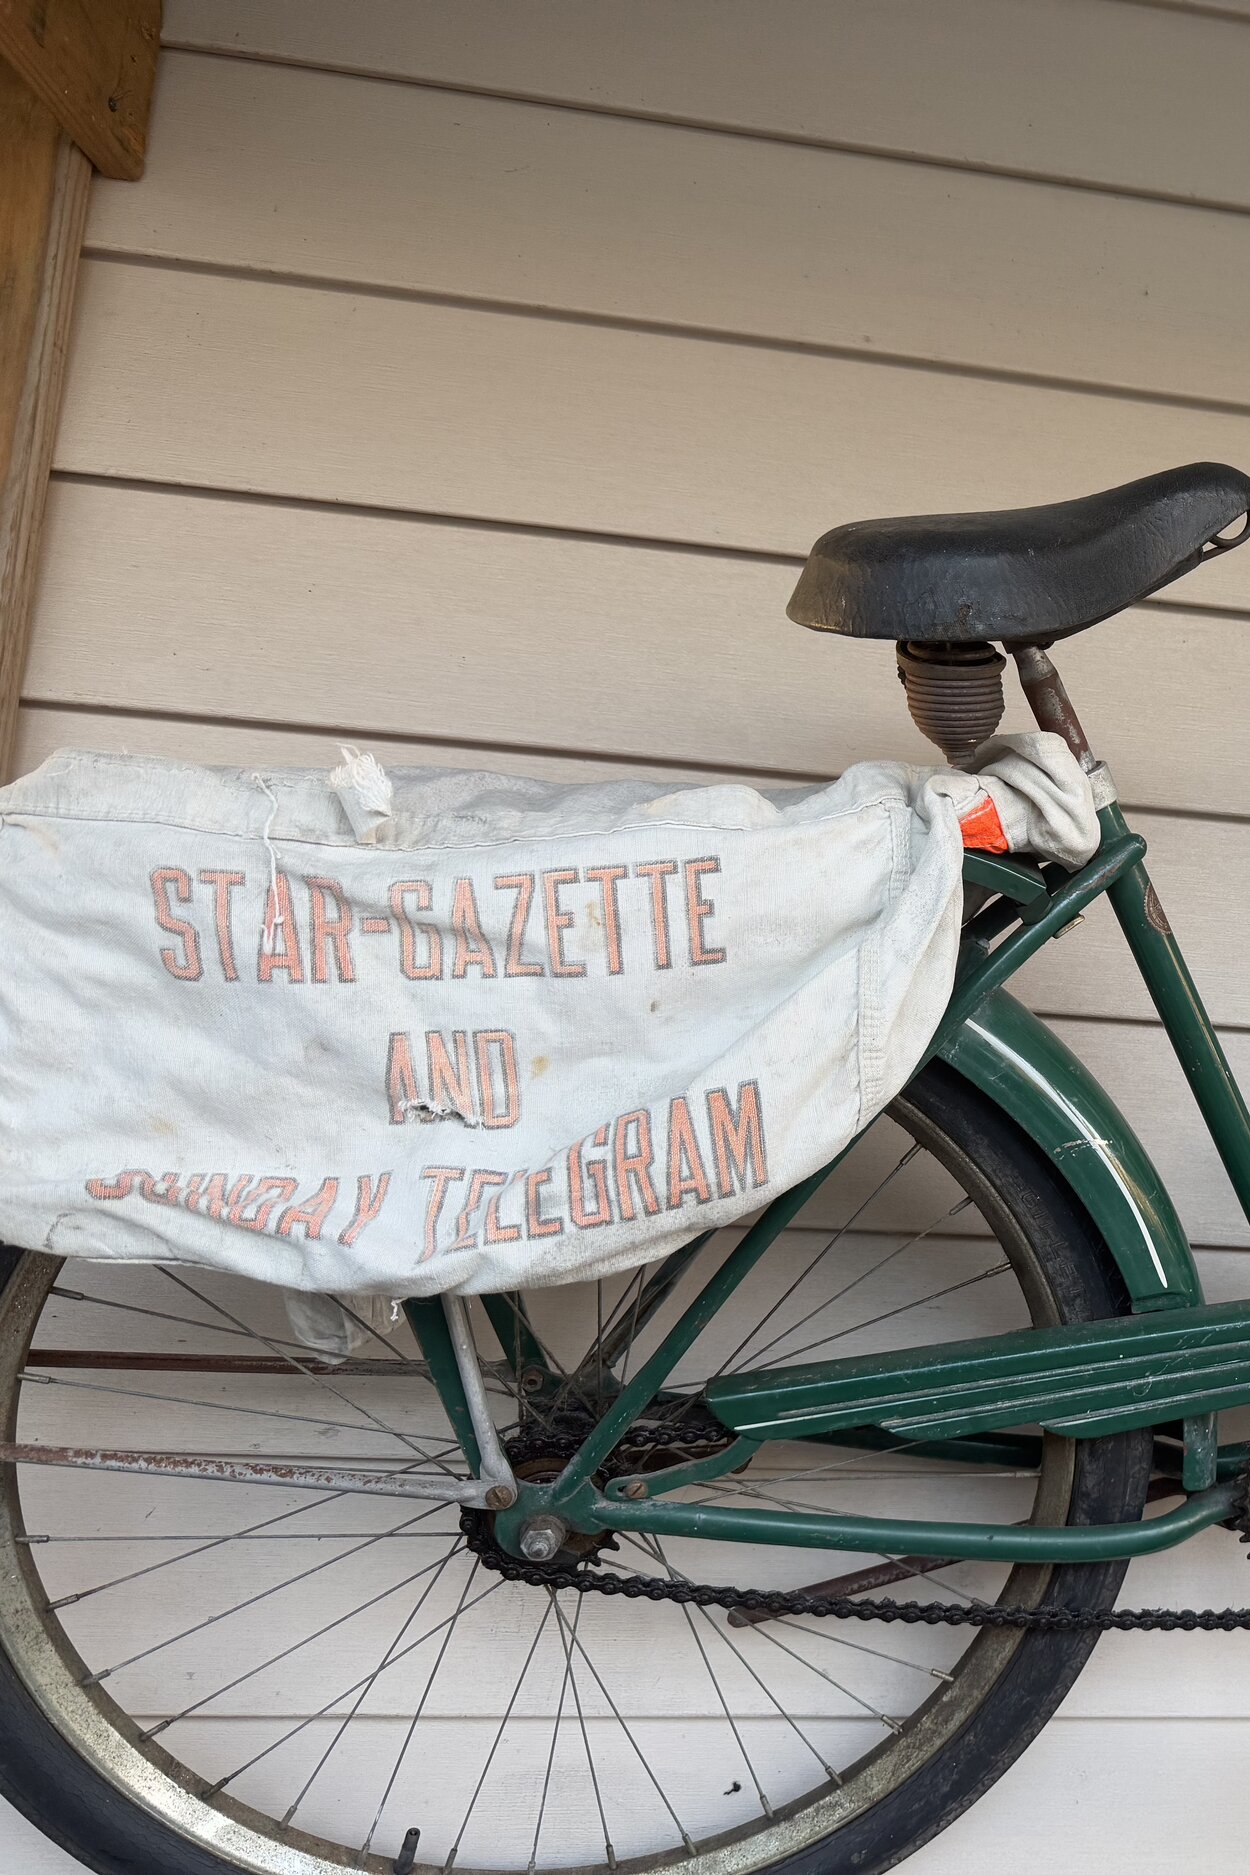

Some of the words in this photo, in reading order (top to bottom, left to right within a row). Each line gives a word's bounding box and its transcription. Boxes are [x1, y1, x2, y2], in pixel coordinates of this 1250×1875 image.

[149, 855, 727, 985] STAR-GAZETTE
[385, 1029, 521, 1130] AND
[86, 1167, 394, 1247] SUNDAY
[416, 1079, 769, 1265] TELEGRAM
